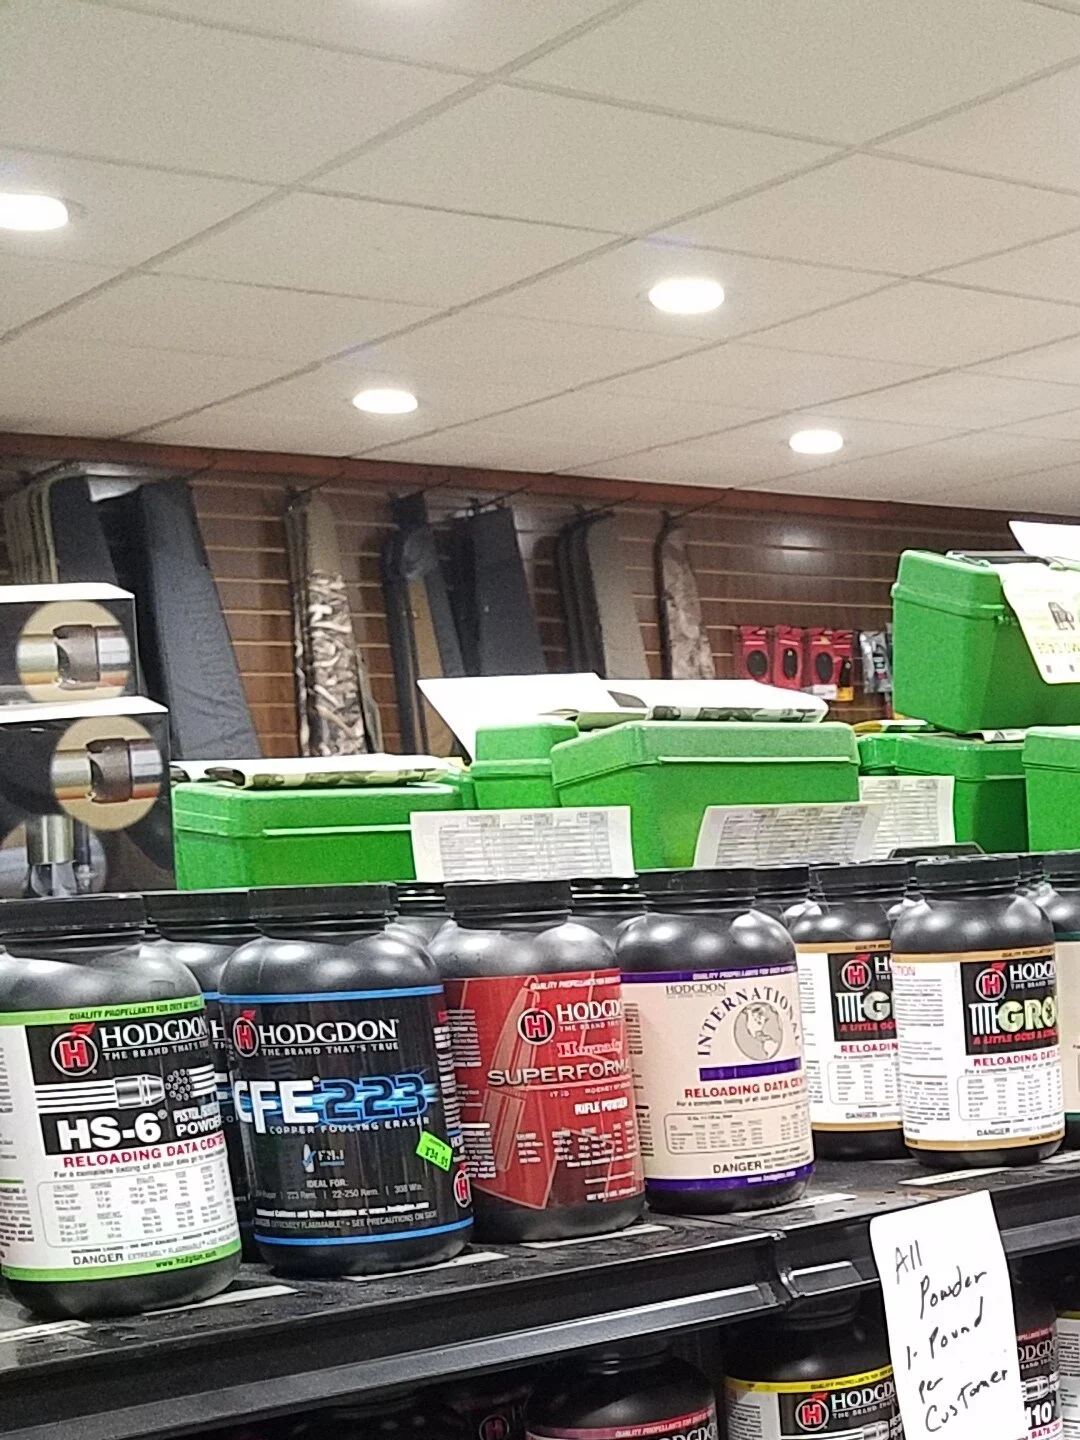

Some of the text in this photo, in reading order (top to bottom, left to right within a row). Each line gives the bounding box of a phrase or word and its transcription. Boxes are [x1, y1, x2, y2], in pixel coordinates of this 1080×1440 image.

[69, 1008, 102, 1021] QUALITY
[260, 1019, 398, 1045] HODGDON
[102, 1046, 169, 1061] THE BRAND
[262, 1042, 399, 1057] THE BRAND THAT'S TRUE
[973, 1052, 1039, 1067] RELOADING
[684, 1080, 790, 1099] RELOADING DATA
[234, 1073, 429, 1134] CFE 223
[56, 1112, 161, 1151] HS-6
[269, 1124, 316, 1135] COPPER
[320, 1121, 379, 1134] FOULING
[976, 1127, 1011, 1137] DANGER
[63, 1139, 199, 1169] RELOADING DATA
[712, 1161, 762, 1175] DANGER
[306, 1179, 329, 1188] IDEAL
[332, 1188, 360, 1199] 22-250
[72, 1253, 124, 1266] DANGER
[895, 1240, 923, 1284] All
[920, 1265, 988, 1320] Powder
[929, 1296, 984, 1359] Pound
[918, 1376, 943, 1404] per
